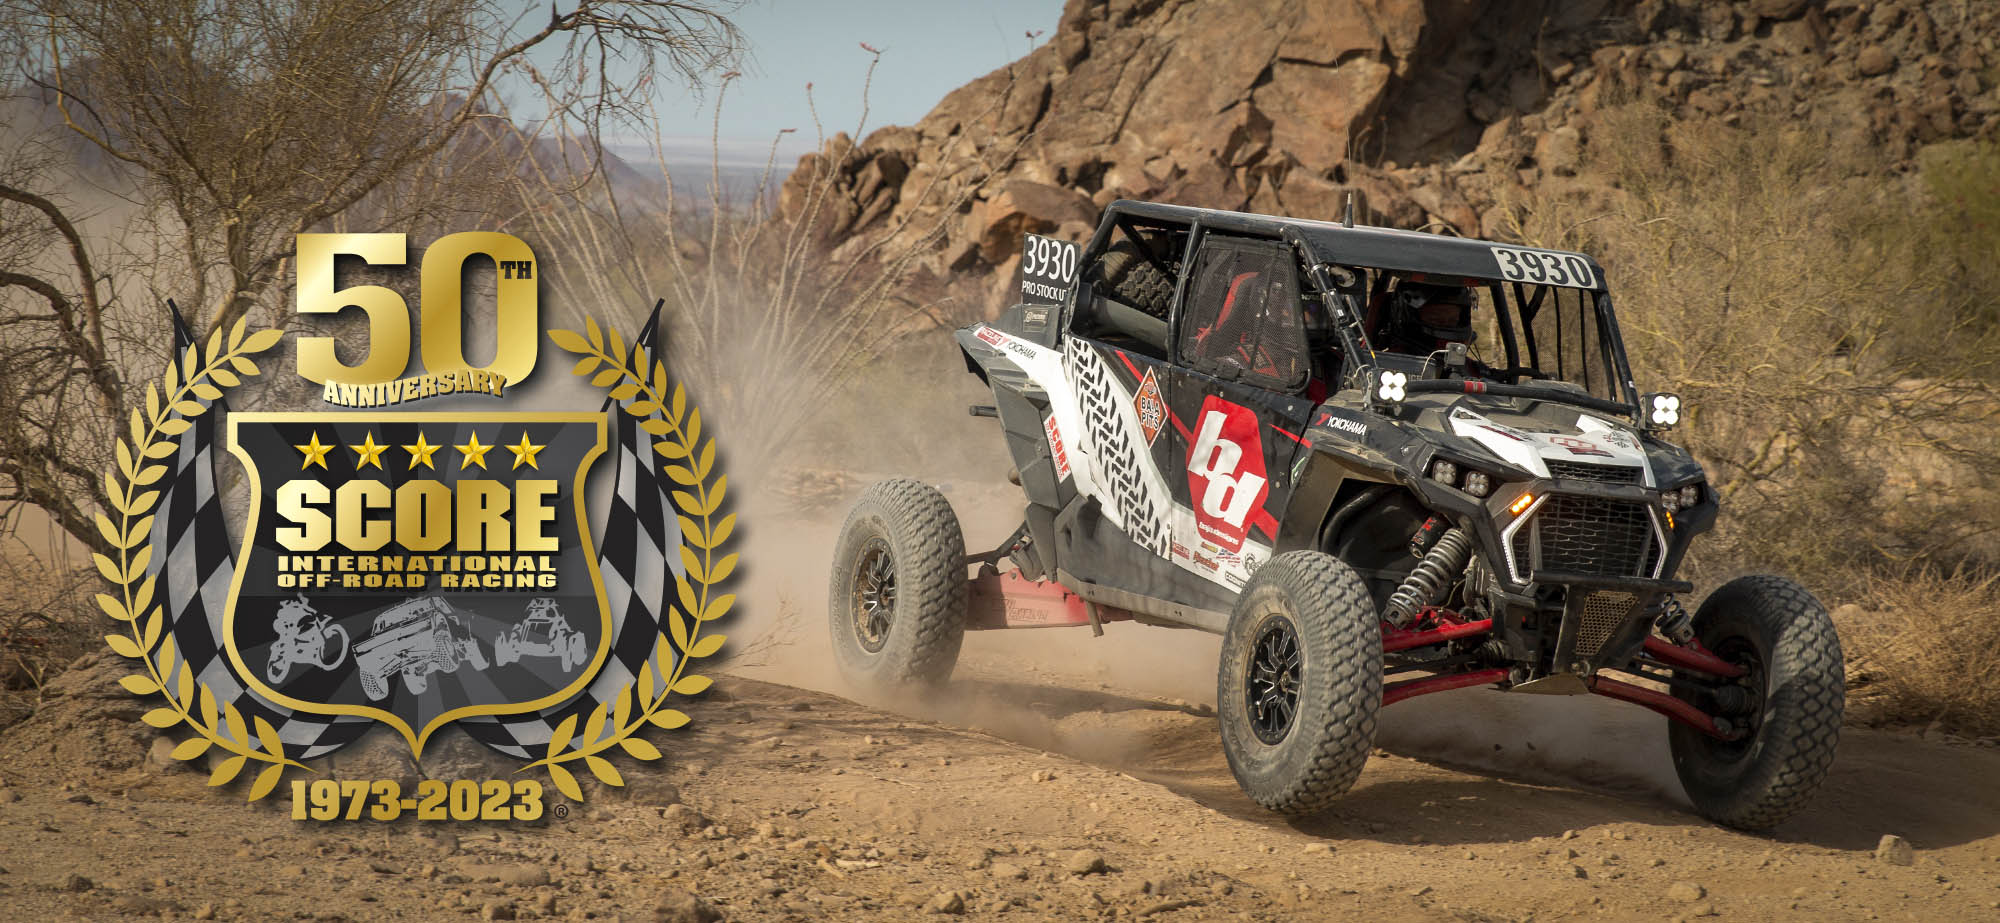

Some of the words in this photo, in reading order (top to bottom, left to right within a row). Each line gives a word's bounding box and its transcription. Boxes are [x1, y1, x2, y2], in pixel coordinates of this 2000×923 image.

[1024, 235, 1076, 283] 3930
[1497, 249, 1592, 287] 3930
[1021, 280, 1036, 295] PRO
[1036, 284, 1059, 300] STOCK
[1140, 412, 1159, 431] PITS
[1327, 416, 1368, 436] YOKOHAMA
[1048, 415, 1071, 473] SCORE
